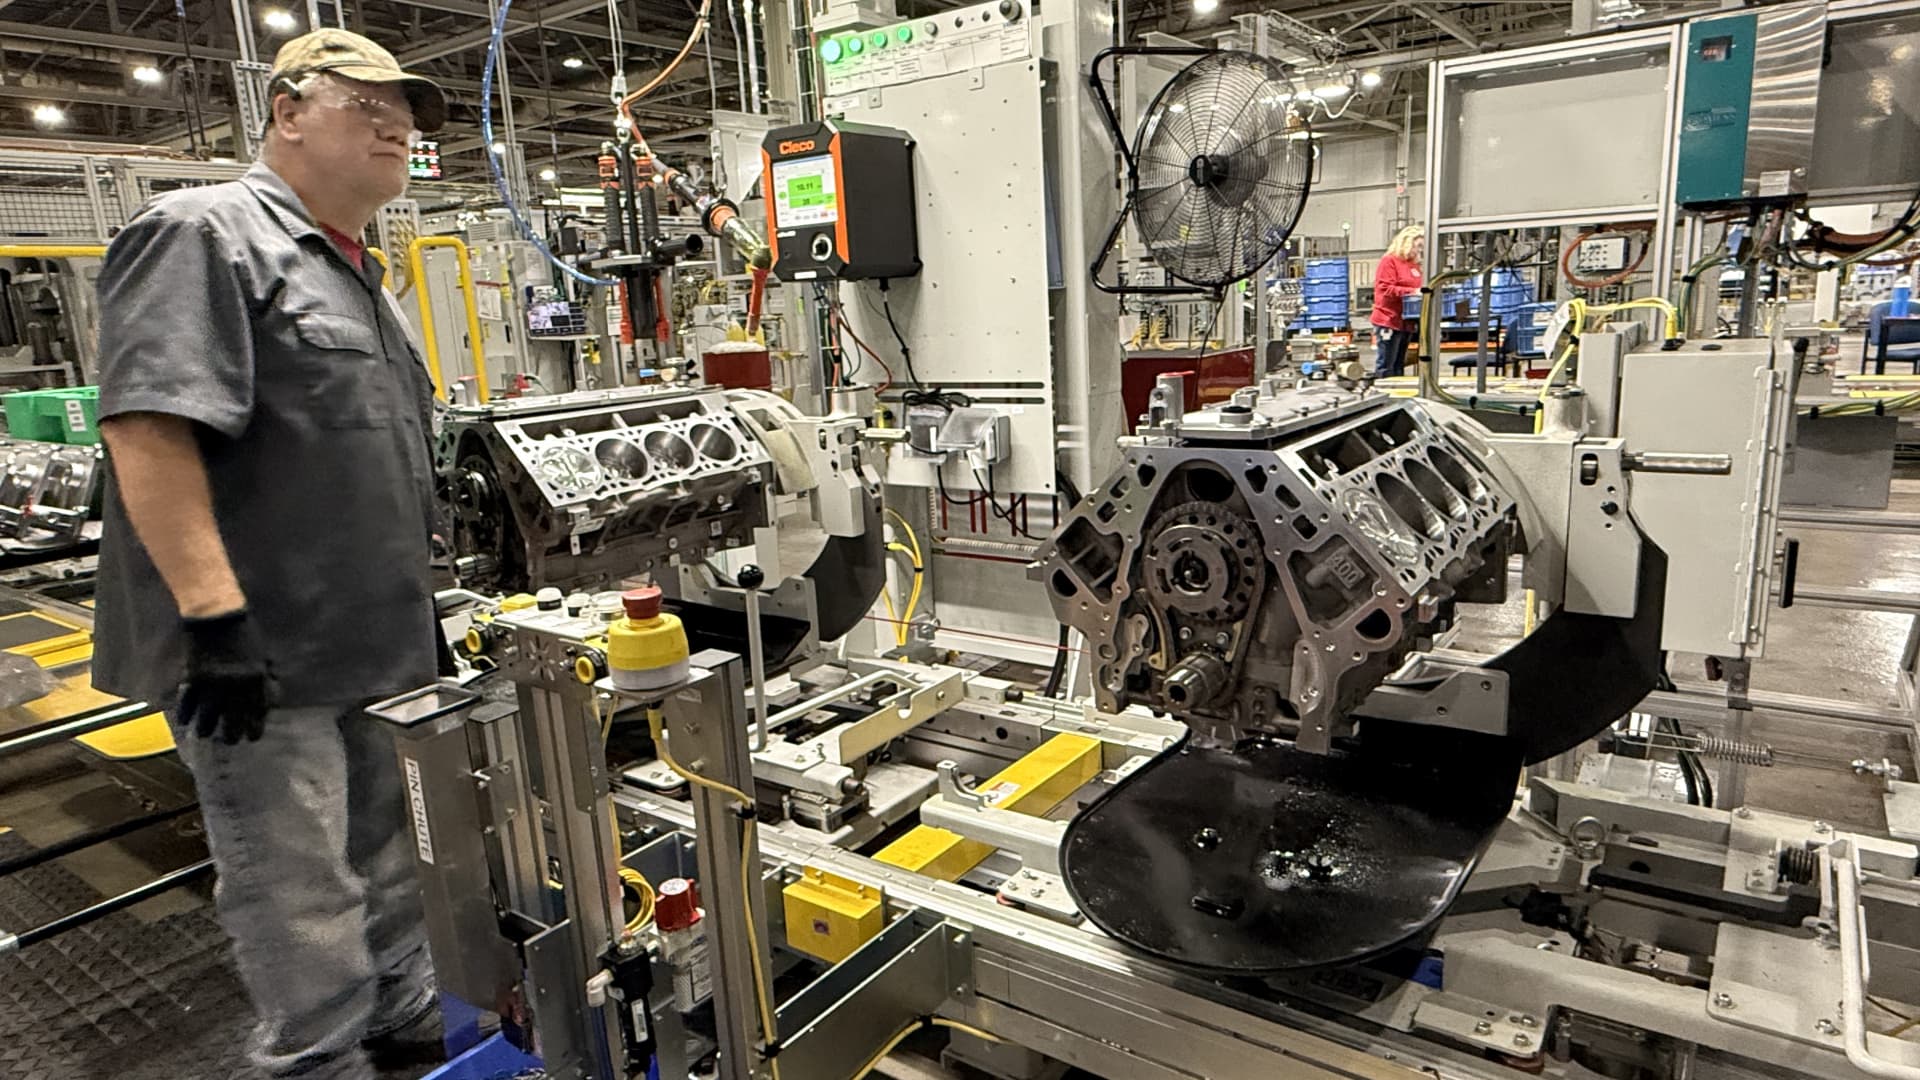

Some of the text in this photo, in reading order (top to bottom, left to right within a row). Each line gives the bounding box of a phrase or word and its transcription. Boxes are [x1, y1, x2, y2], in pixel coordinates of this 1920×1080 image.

[779, 140, 815, 154] Cleco
[407, 761, 433, 860] PIN CHUTE
